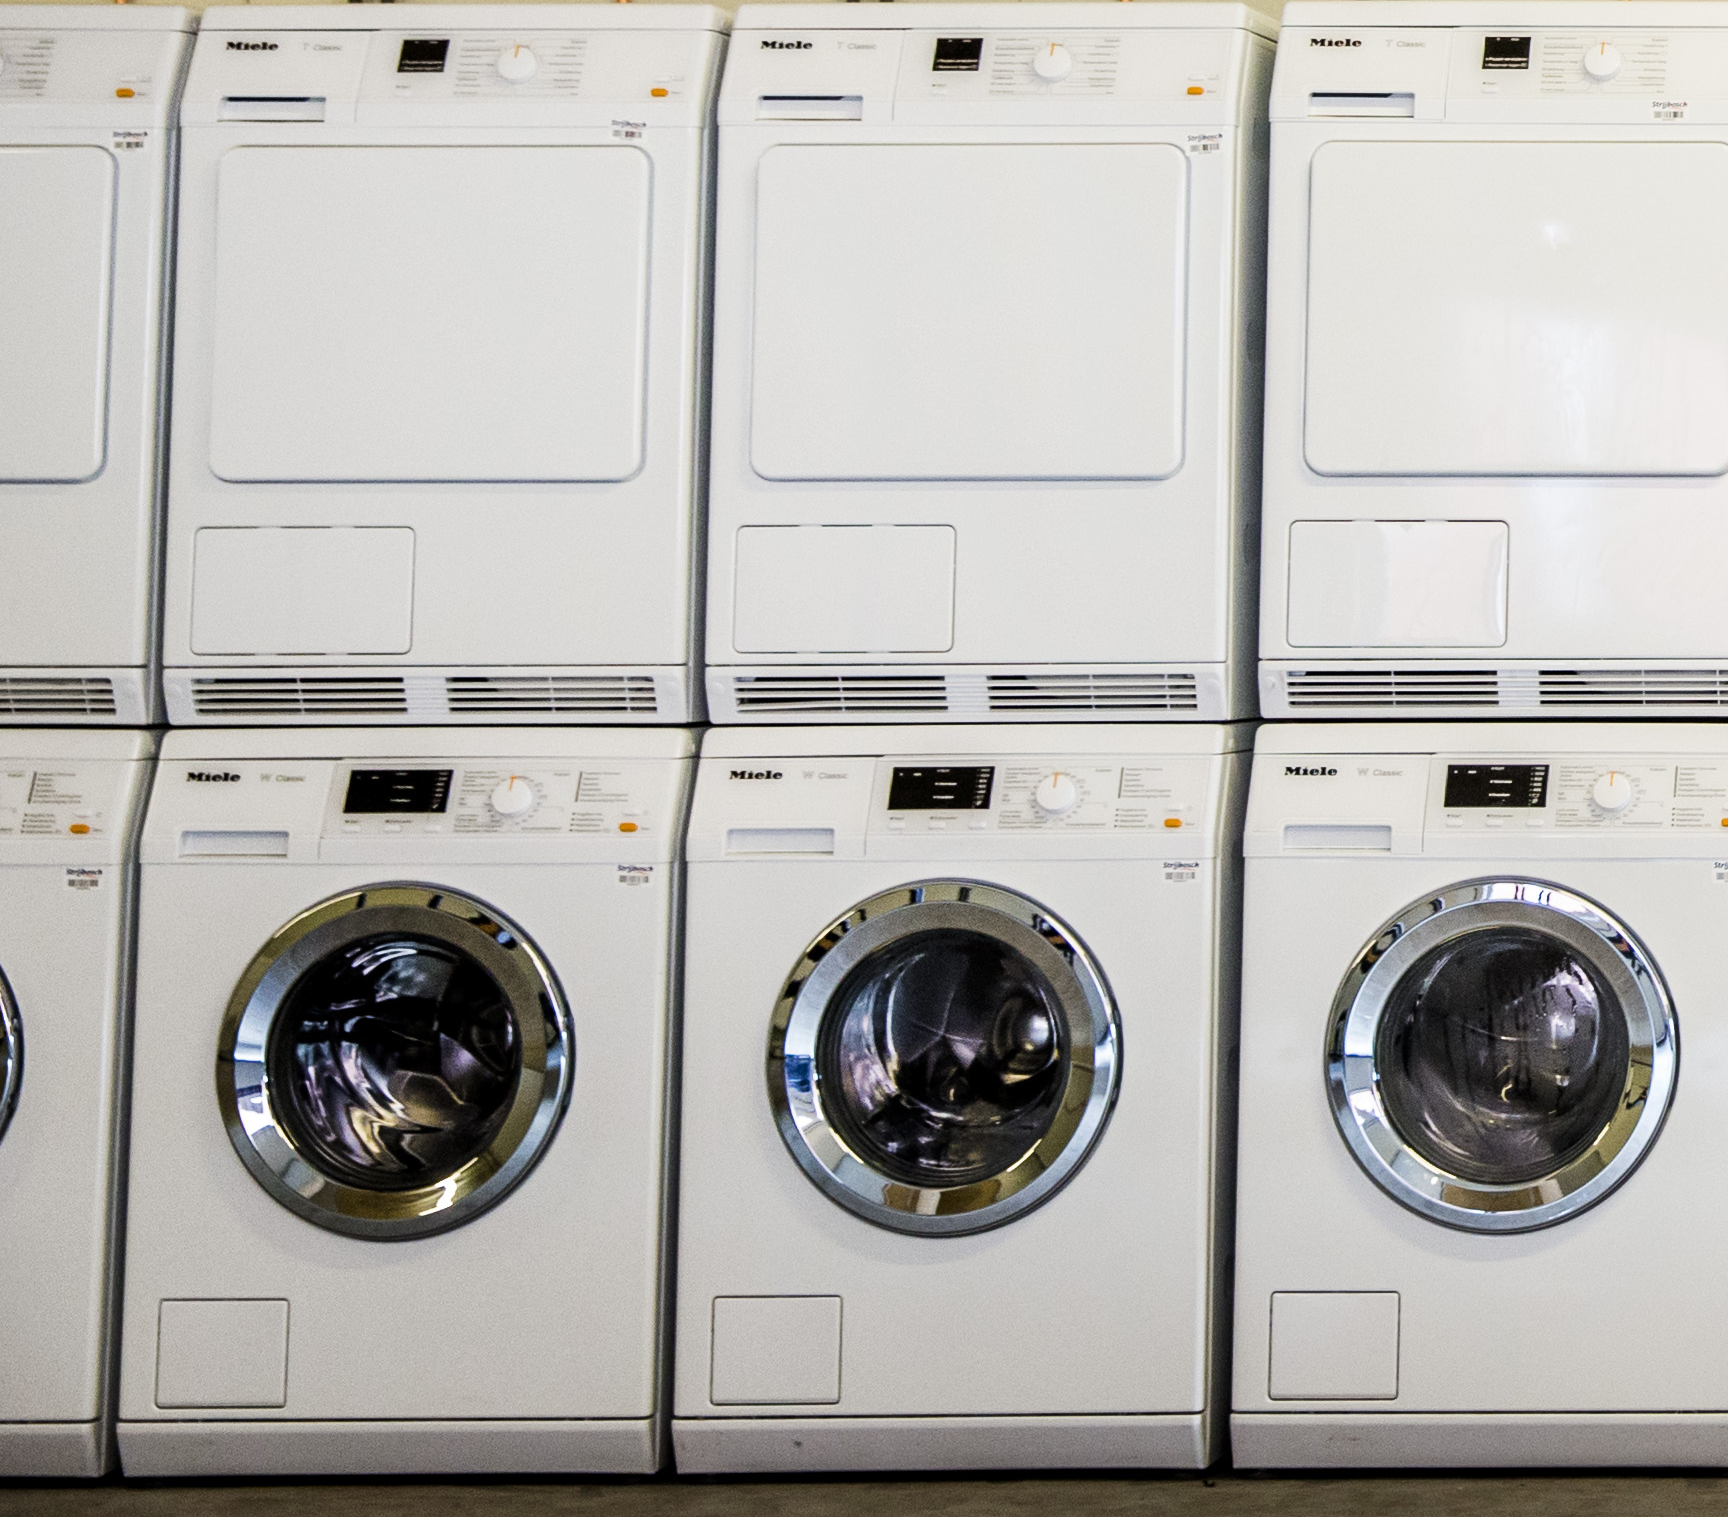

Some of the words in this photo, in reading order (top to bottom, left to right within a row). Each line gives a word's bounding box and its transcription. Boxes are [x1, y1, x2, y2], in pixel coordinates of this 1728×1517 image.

[226, 41, 279, 51] Miele
[760, 40, 813, 50] Miele
[1310, 38, 1362, 48] Miele
[1396, 40, 1425, 48] Classic
[729, 769, 783, 780] Miele
[1284, 766, 1338, 777] Miele
[1372, 768, 1403, 777] Classic
[186, 771, 241, 783] Miele
